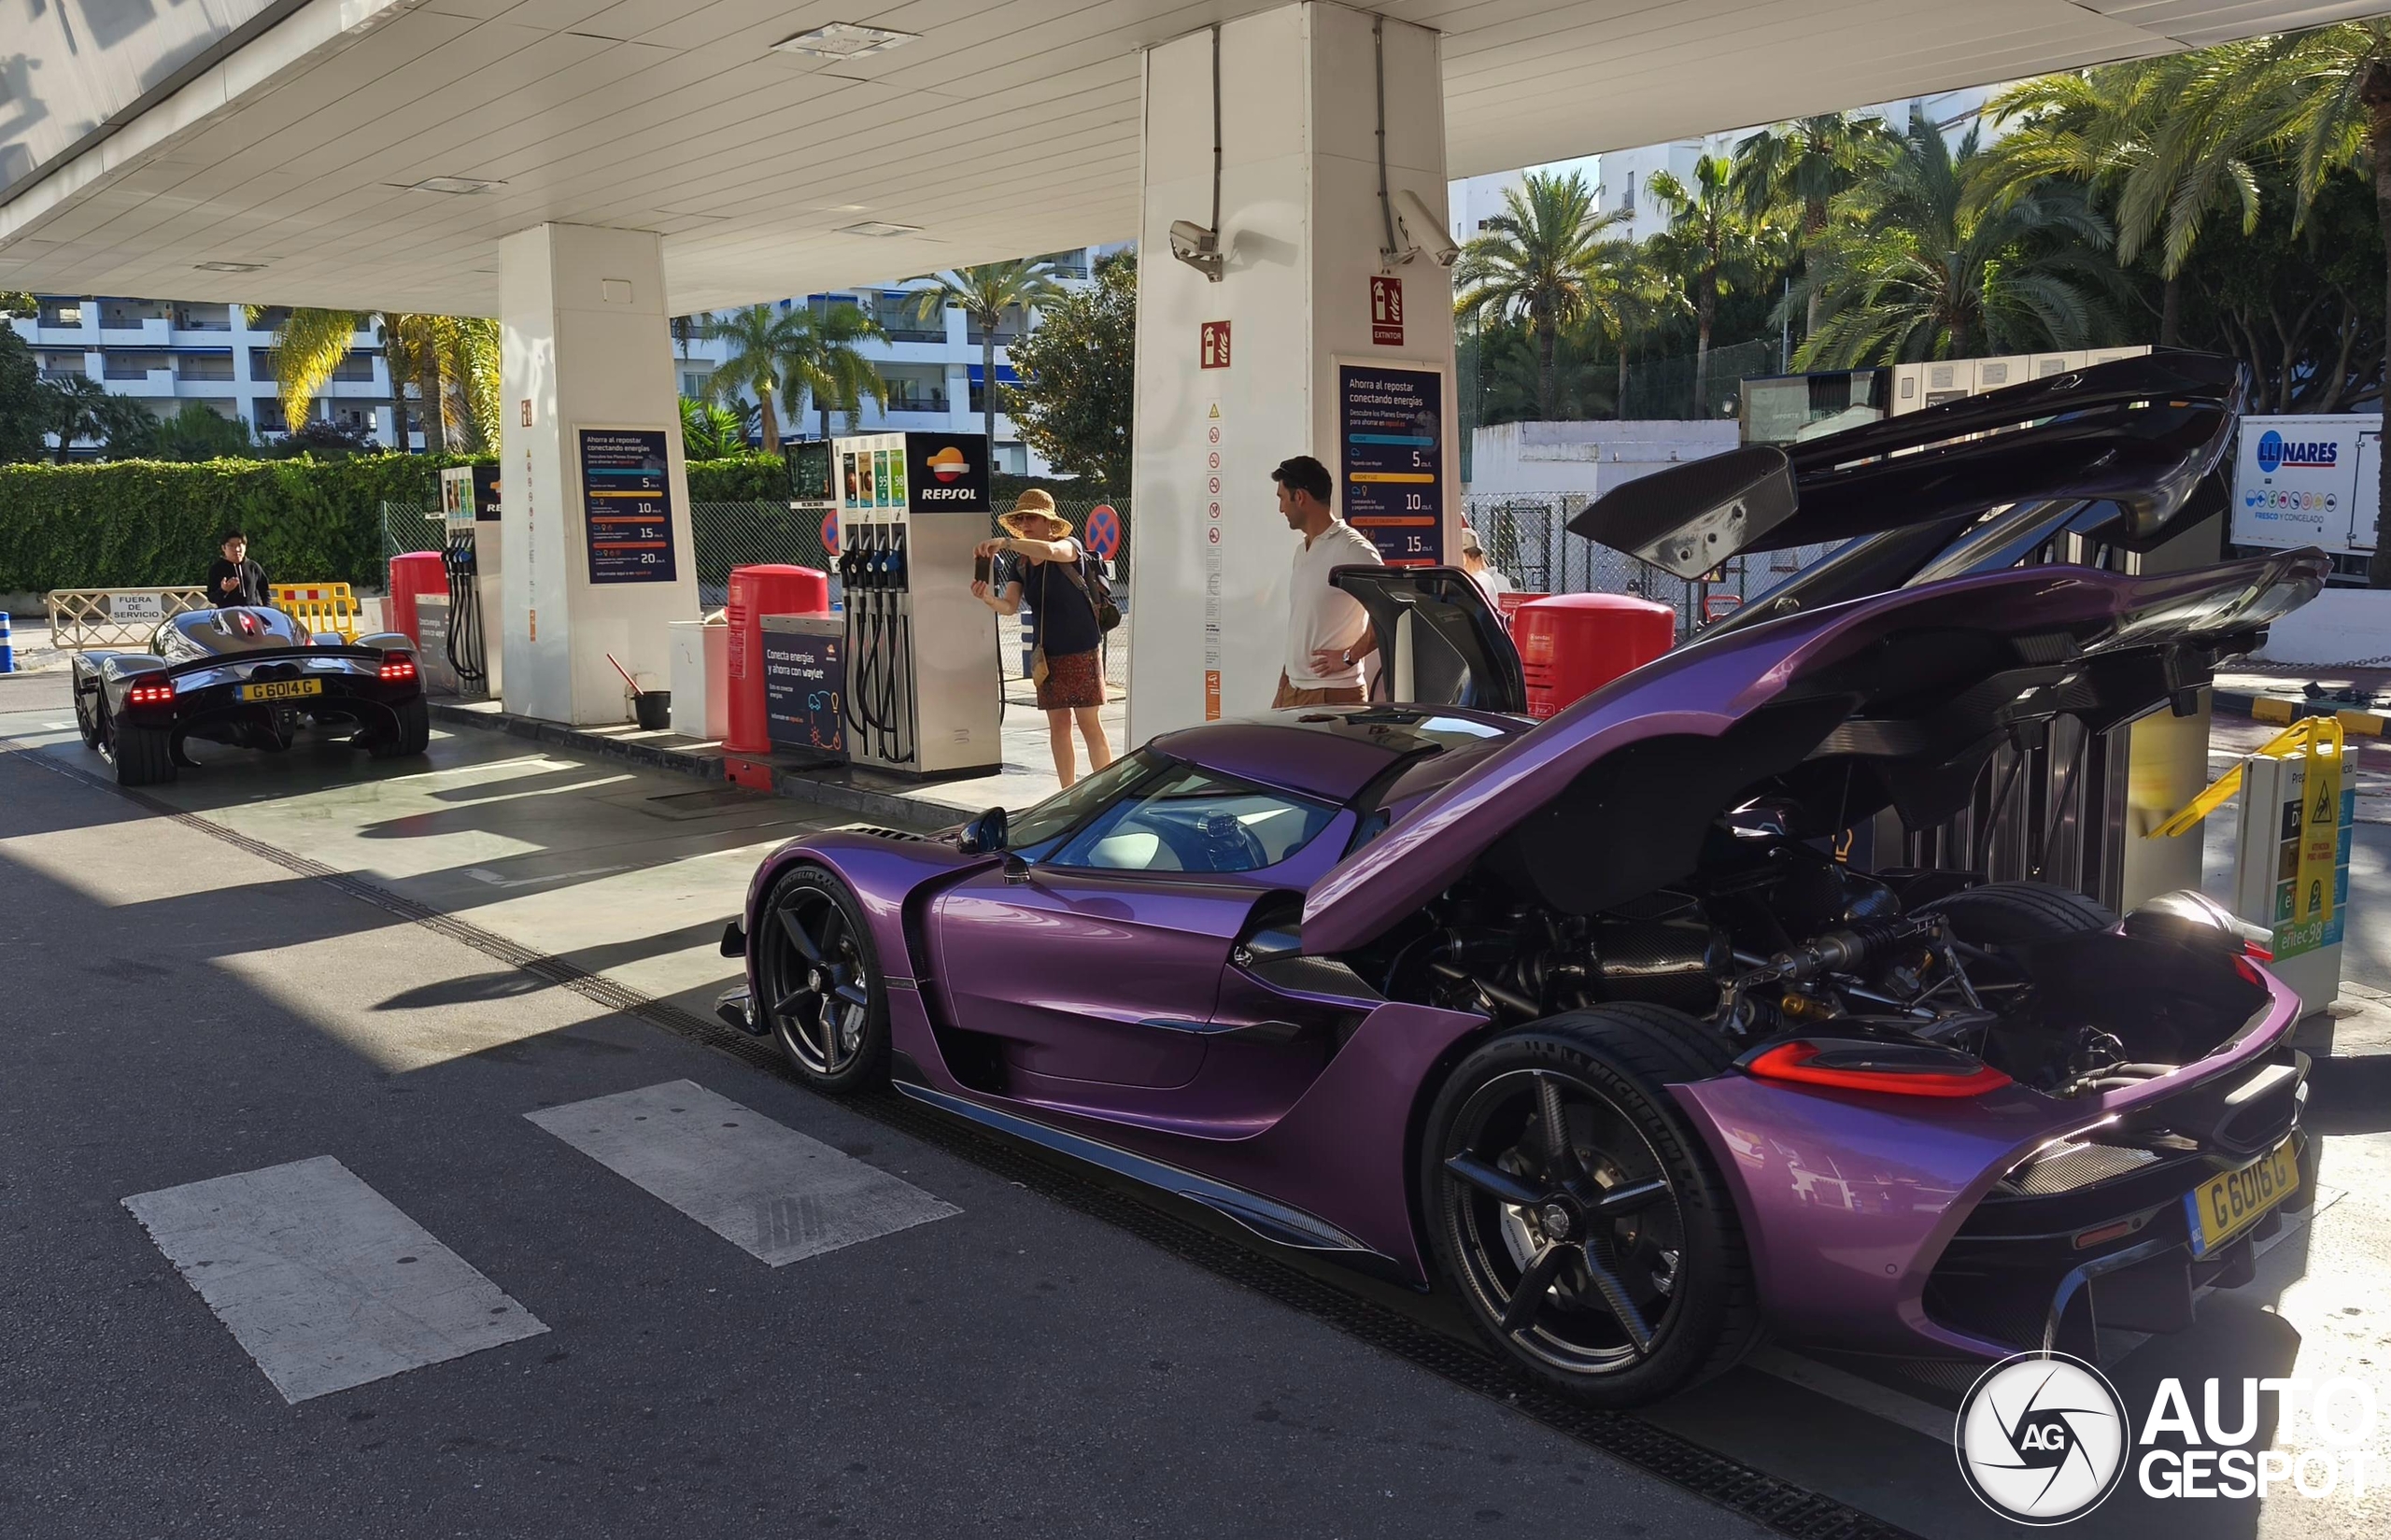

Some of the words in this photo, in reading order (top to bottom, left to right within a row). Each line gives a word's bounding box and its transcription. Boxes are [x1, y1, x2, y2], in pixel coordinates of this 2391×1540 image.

[1374, 331, 1402, 339] EXTINTOR
[1350, 378, 1374, 389] Ahorra
[1376, 379, 1383, 389] al
[1384, 381, 1414, 392] repostar
[1350, 393, 1393, 404] conectando
[1394, 395, 1423, 408] energías
[624, 445, 650, 453] energías
[2258, 442, 2338, 463] LLINARES
[1412, 451, 1421, 467] 5
[642, 477, 650, 487] 5
[878, 475, 887, 487] 95
[894, 474, 904, 487] 98
[921, 488, 977, 500] REPSOL
[638, 502, 652, 514] 10
[1406, 493, 1421, 510] 10
[2255, 512, 2279, 520] FRESCO
[2285, 514, 2324, 523] CONGELADO
[640, 528, 654, 538] 15
[1407, 536, 1422, 552] 15
[641, 553, 656, 564] 20
[767, 649, 789, 661] Conecta
[790, 652, 814, 665] energías
[768, 665, 772, 675] y
[772, 664, 790, 675] ahorra
[790, 667, 801, 677] con
[802, 669, 824, 681] waylet
[253, 685, 262, 698] G
[266, 682, 300, 697] 6014
[304, 681, 313, 693] G
[2309, 921, 2323, 943] 98
[1587, 1060, 1684, 1161] MICHELIN
[2211, 1182, 2228, 1229] G
[2228, 1159, 2273, 1218] 6016
[2272, 1150, 2286, 1188] G
